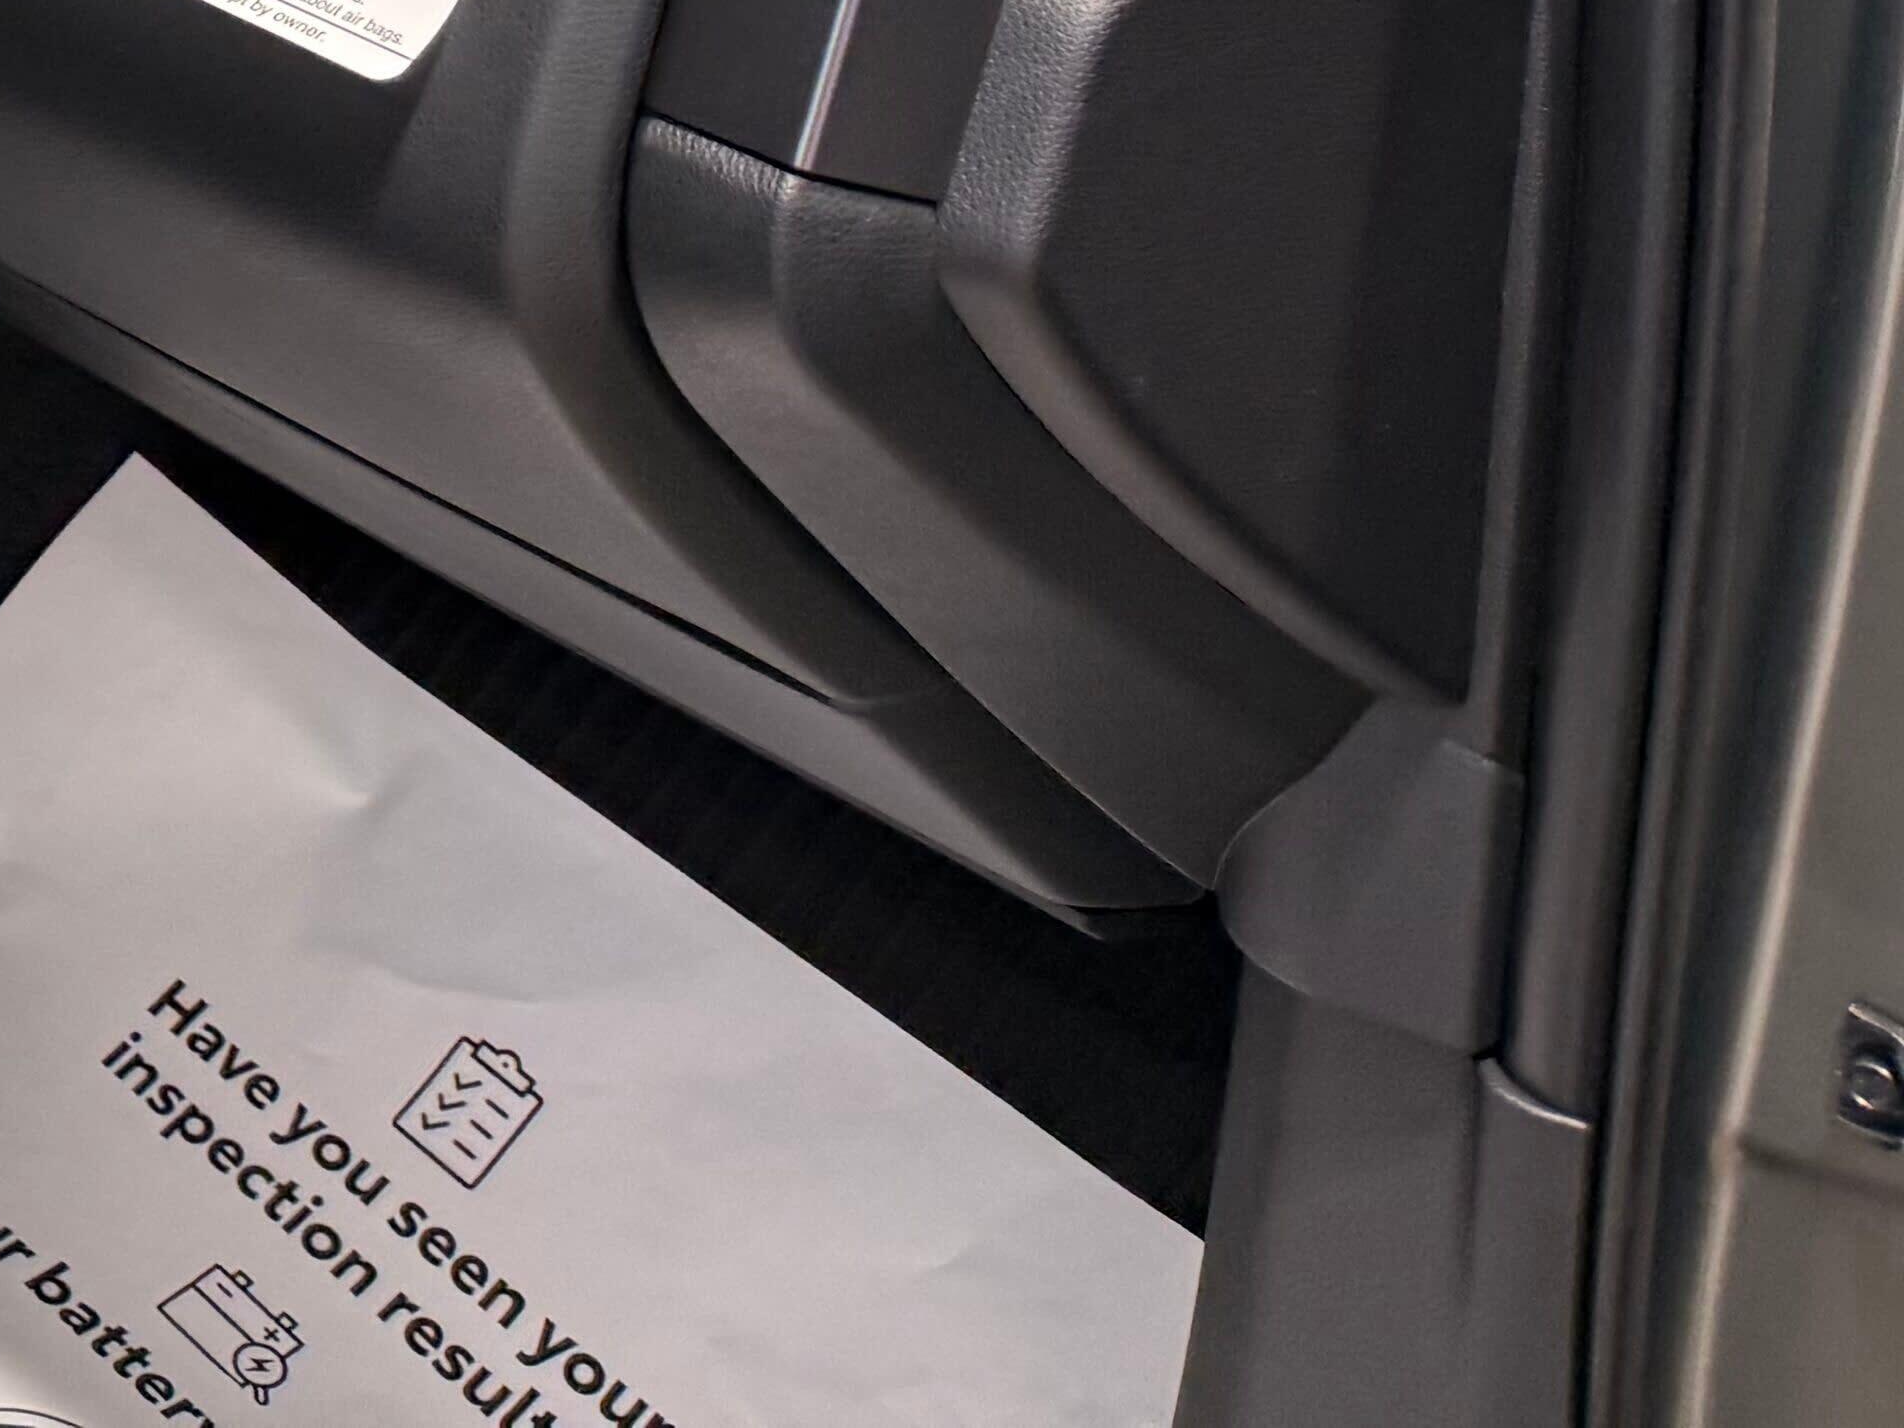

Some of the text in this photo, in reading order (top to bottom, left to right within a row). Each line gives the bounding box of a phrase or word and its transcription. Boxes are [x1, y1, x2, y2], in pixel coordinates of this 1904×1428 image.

[250, 0, 274, 17] by
[273, 11, 327, 43] owner.
[342, 9, 365, 25] air
[364, 18, 403, 45] bags.
[101, 1031, 380, 1299] inspection
[147, 979, 281, 1112] Have
[268, 1102, 391, 1207] you
[387, 1199, 528, 1330] seen
